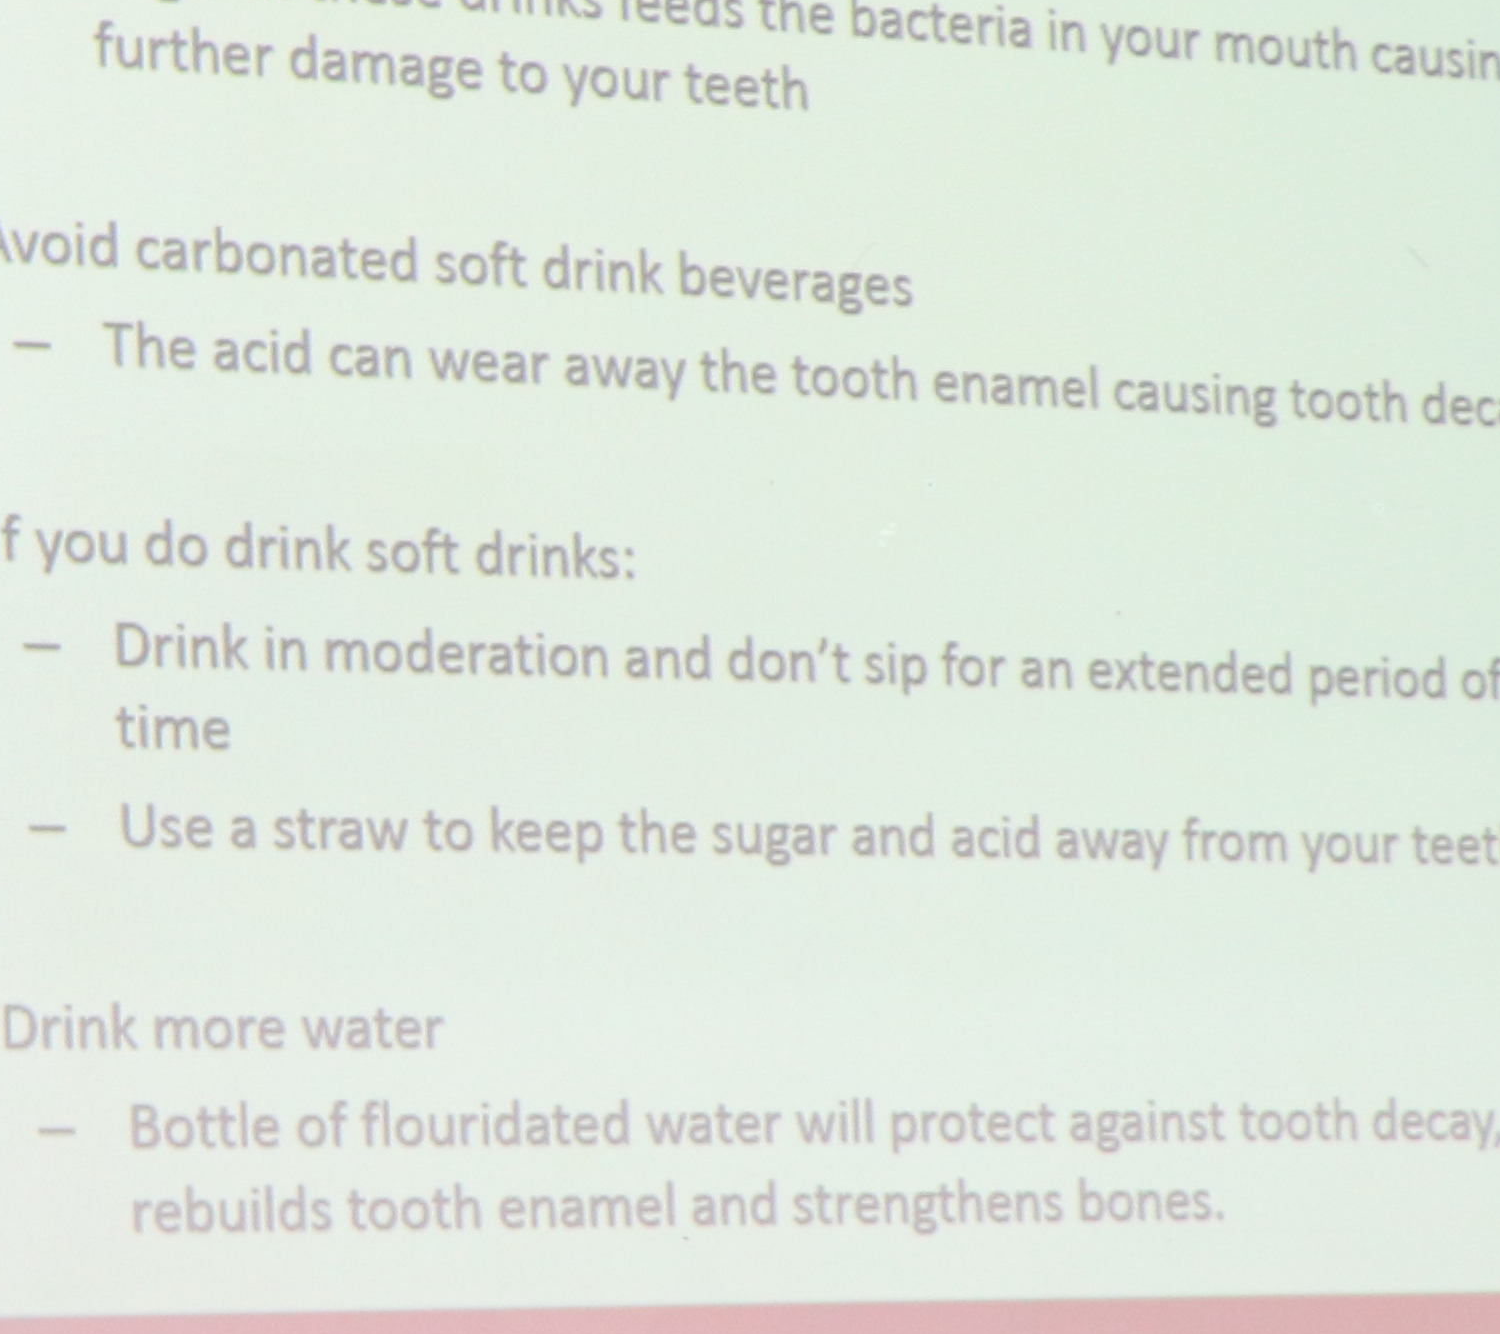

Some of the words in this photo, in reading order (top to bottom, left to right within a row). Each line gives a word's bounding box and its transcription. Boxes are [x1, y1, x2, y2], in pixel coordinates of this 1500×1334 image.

[91, 19, 275, 79] further
[286, 33, 484, 102] damage
[495, 51, 549, 97] to
[560, 63, 671, 109] your
[681, 63, 810, 112] teeth
[1046, 9, 1087, 53] in
[1098, 22, 1201, 66] your
[1212, 26, 1358, 71] mouth
[133, 225, 419, 285] carbonated
[433, 239, 528, 290] soft
[539, 243, 664, 296] drink
[675, 249, 914, 318] beverages
[100, 320, 198, 373] The
[211, 327, 313, 378] acid
[326, 342, 413, 381] can
[426, 347, 550, 387] wear
[562, 353, 687, 403] away
[696, 346, 777, 397] the
[788, 354, 918, 402] tooth
[931, 364, 1099, 411] enamel
[1111, 378, 1278, 430] causing
[1286, 378, 1408, 424] tooth
[32, 528, 129, 576] you
[142, 518, 209, 570] do
[222, 520, 352, 573] drink
[364, 526, 461, 577] soft
[472, 528, 635, 582] drinks:
[113, 620, 250, 671] Drink
[263, 625, 309, 672] in
[322, 626, 609, 680] moderation
[622, 633, 712, 682] and
[862, 641, 929, 697] sip
[938, 640, 1007, 689] for
[1017, 655, 1074, 691] an
[1085, 648, 1293, 697] extended
[1306, 655, 1447, 707] period
[113, 703, 232, 753] time
[118, 802, 214, 851] Use
[228, 815, 257, 851] a
[272, 807, 409, 853] straw
[421, 810, 475, 854] to
[488, 805, 605, 865] keep
[615, 807, 697, 856] the
[710, 821, 838, 869] sugar
[849, 811, 935, 859] and
[949, 813, 1041, 860] acid
[1053, 826, 1169, 872] away
[1180, 815, 1288, 863] from
[1299, 831, 1399, 874] your
[1, 1002, 138, 1052] Drink
[152, 1015, 285, 1051] more
[300, 1008, 444, 1051] water
[129, 1101, 280, 1151] Bottle
[295, 1099, 347, 1150] of
[359, 1099, 630, 1149] flouridated
[644, 1104, 781, 1146] water
[795, 1098, 874, 1145] will
[889, 1103, 1055, 1154] protect
[1068, 1103, 1225, 1155] against
[1237, 1097, 1358, 1142] tooth
[131, 1185, 333, 1235] rebuilds
[346, 1183, 482, 1232] tooth
[497, 1180, 675, 1231] enamel
[690, 1179, 777, 1228] and
[792, 1178, 1063, 1236] strengthens
[1077, 1177, 1224, 1223] bones.
